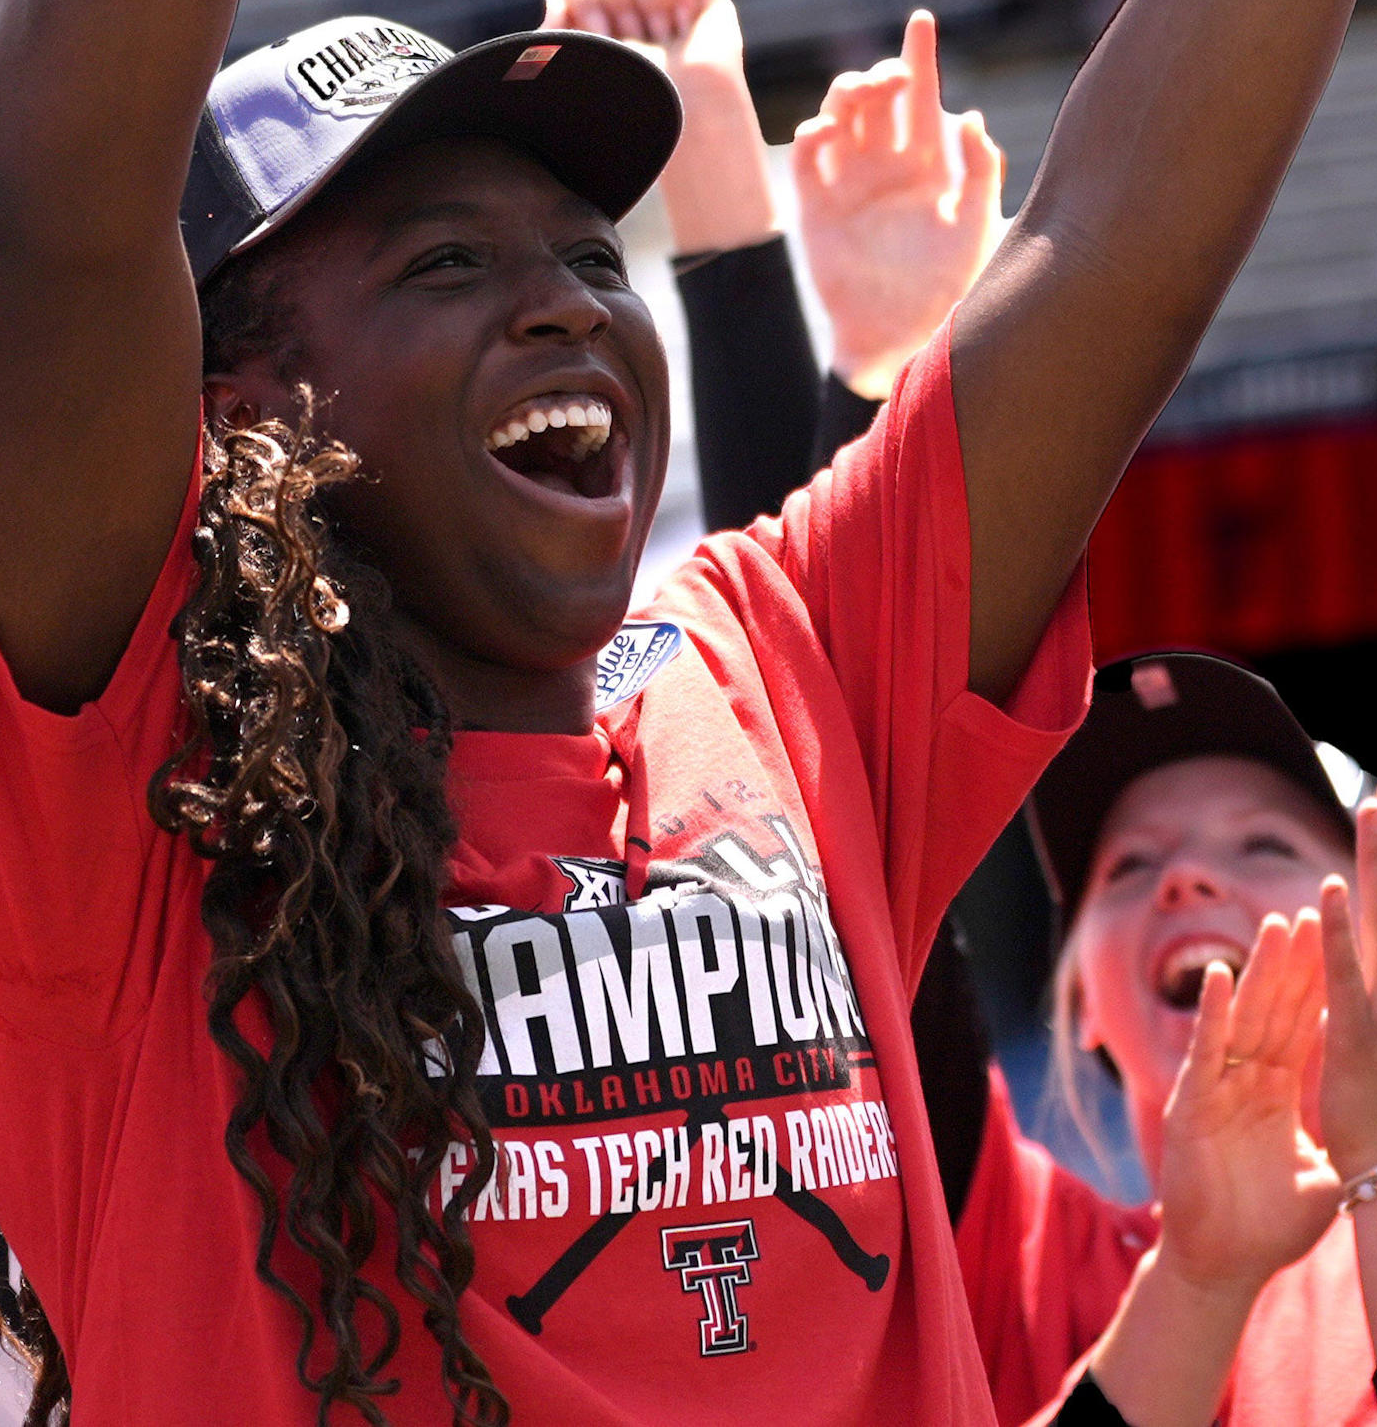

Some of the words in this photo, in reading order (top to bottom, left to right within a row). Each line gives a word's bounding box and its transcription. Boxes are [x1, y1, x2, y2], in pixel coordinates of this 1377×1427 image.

[505, 1056, 756, 1119] OKLAHOMA
[773, 1047, 837, 1087] CITY
[571, 1121, 690, 1215] TECH
[700, 1114, 777, 1205] RED
